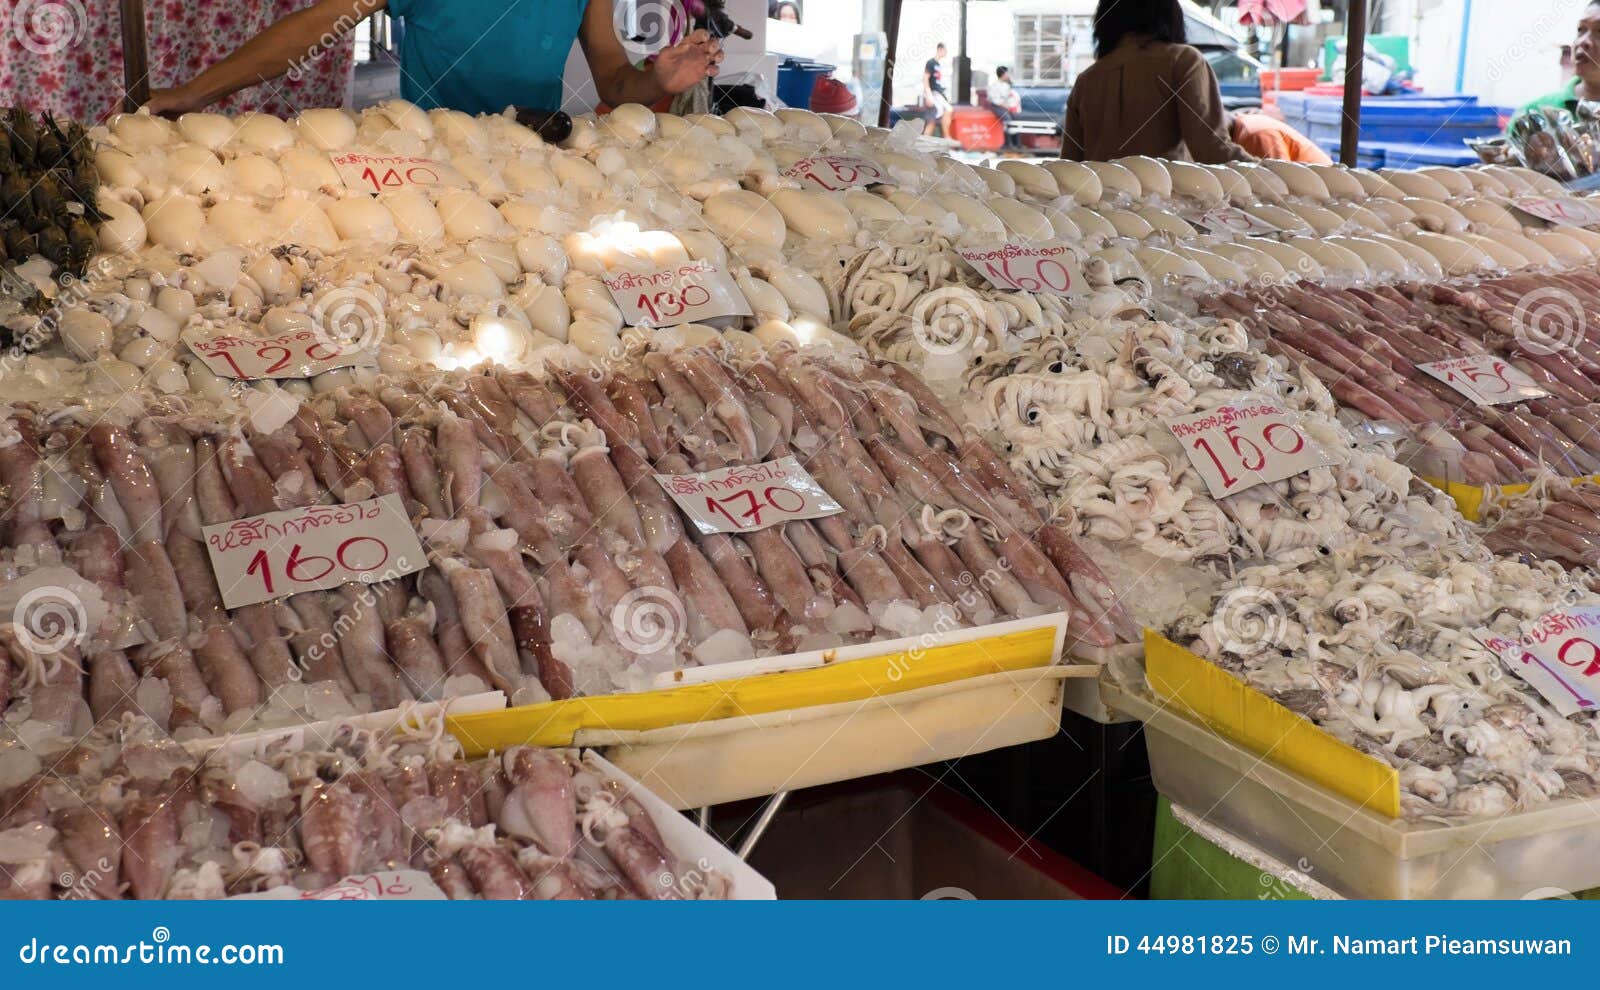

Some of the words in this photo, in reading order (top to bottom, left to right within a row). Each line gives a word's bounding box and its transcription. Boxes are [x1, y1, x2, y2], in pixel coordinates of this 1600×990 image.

[984, 258, 1070, 291] 160
[637, 285, 710, 321] 130
[206, 343, 343, 380] 120
[1193, 423, 1304, 488] 150
[705, 486, 805, 529] 170
[246, 536, 388, 593] 160
